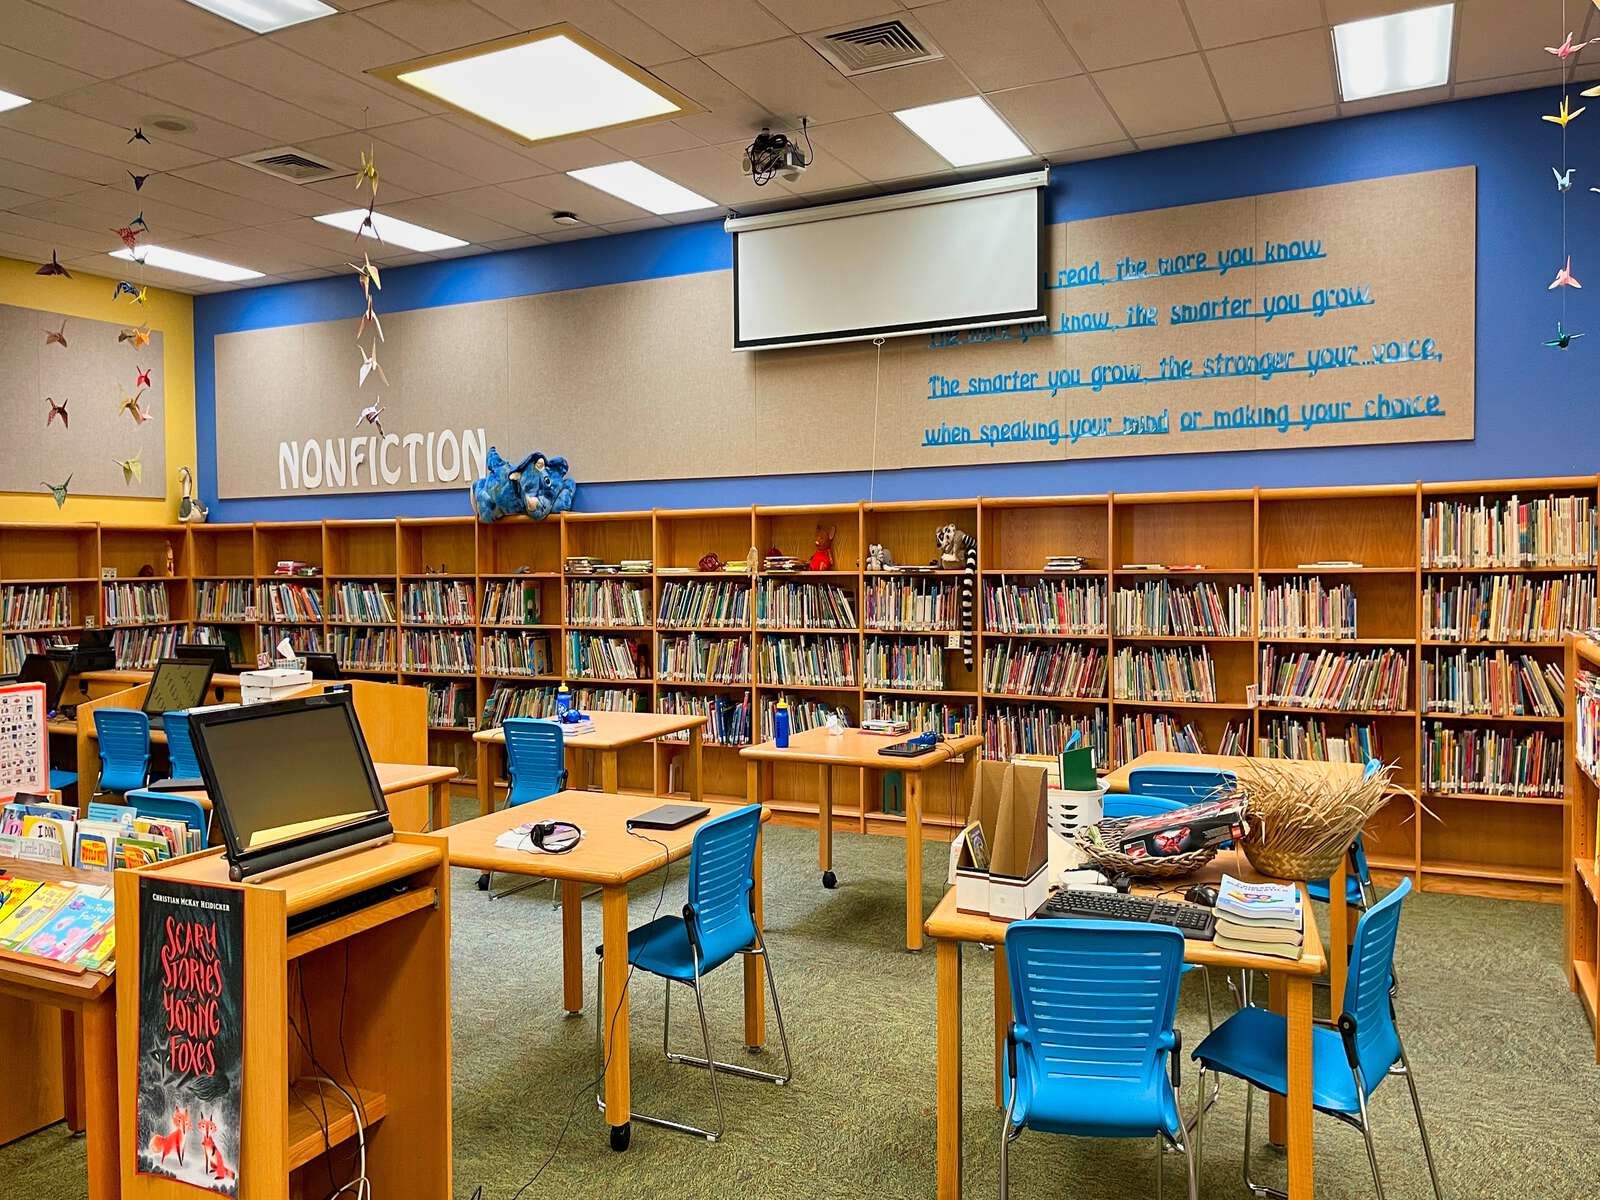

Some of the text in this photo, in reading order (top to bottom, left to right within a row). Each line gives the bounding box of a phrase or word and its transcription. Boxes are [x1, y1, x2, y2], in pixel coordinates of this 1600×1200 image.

[1115, 256, 1148, 280] the
[1157, 250, 1207, 275] more
[1217, 246, 1255, 276] you
[1126, 303, 1158, 327] the
[1170, 295, 1253, 324] smarter
[1263, 291, 1300, 323] you
[928, 374, 961, 399] The
[968, 369, 1039, 395] smarter
[1048, 367, 1081, 398] you
[1159, 355, 1194, 379] the
[1202, 350, 1295, 380] stronger
[924, 422, 971, 446] when
[979, 418, 1060, 448] speaking
[1069, 414, 1112, 444] your
[1122, 408, 1170, 437] mind
[1180, 408, 1203, 432] or
[1213, 402, 1289, 433] making
[1301, 399, 1352, 432] your
[278, 427, 488, 490] NONFICTION
[200, 900, 231, 912] HEIDICKER
[165, 915, 217, 961] SCARY
[163, 990, 220, 1040] YOUNG
[169, 1034, 216, 1079] FOXES
